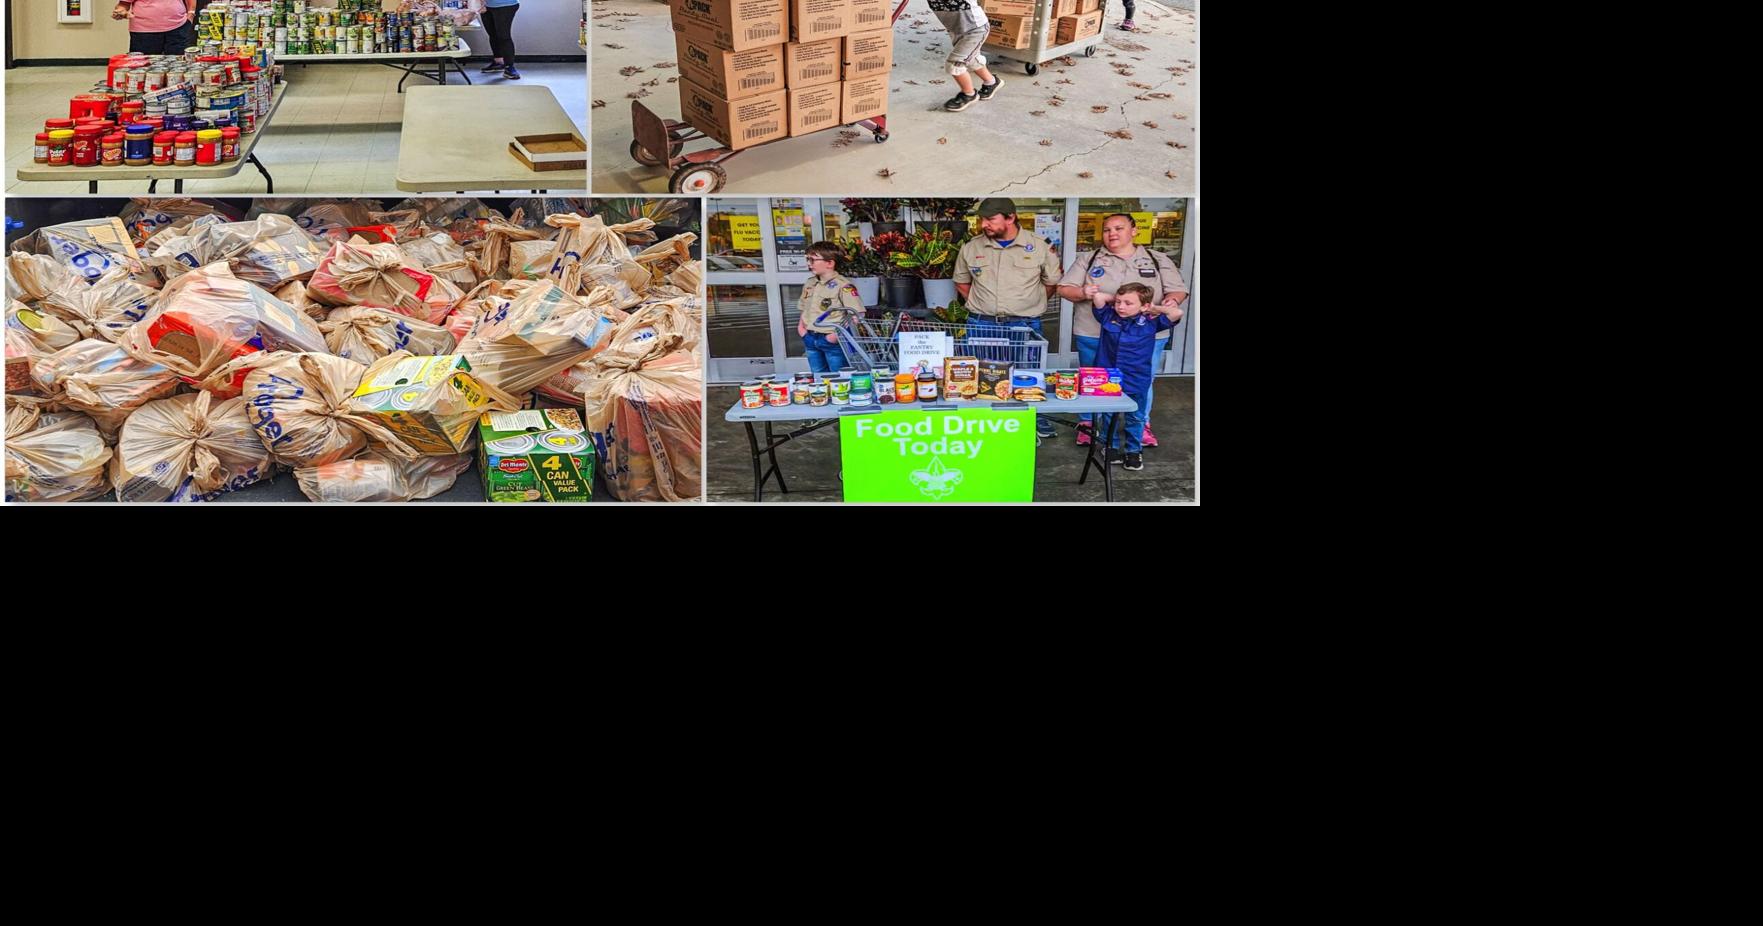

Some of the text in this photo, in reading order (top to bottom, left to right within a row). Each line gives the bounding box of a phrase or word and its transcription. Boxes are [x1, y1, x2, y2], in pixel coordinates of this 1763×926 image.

[855, 415, 1021, 438] Food Drive
[893, 436, 984, 460] Today
[542, 455, 563, 471] 4
[546, 471, 570, 480] CAN
